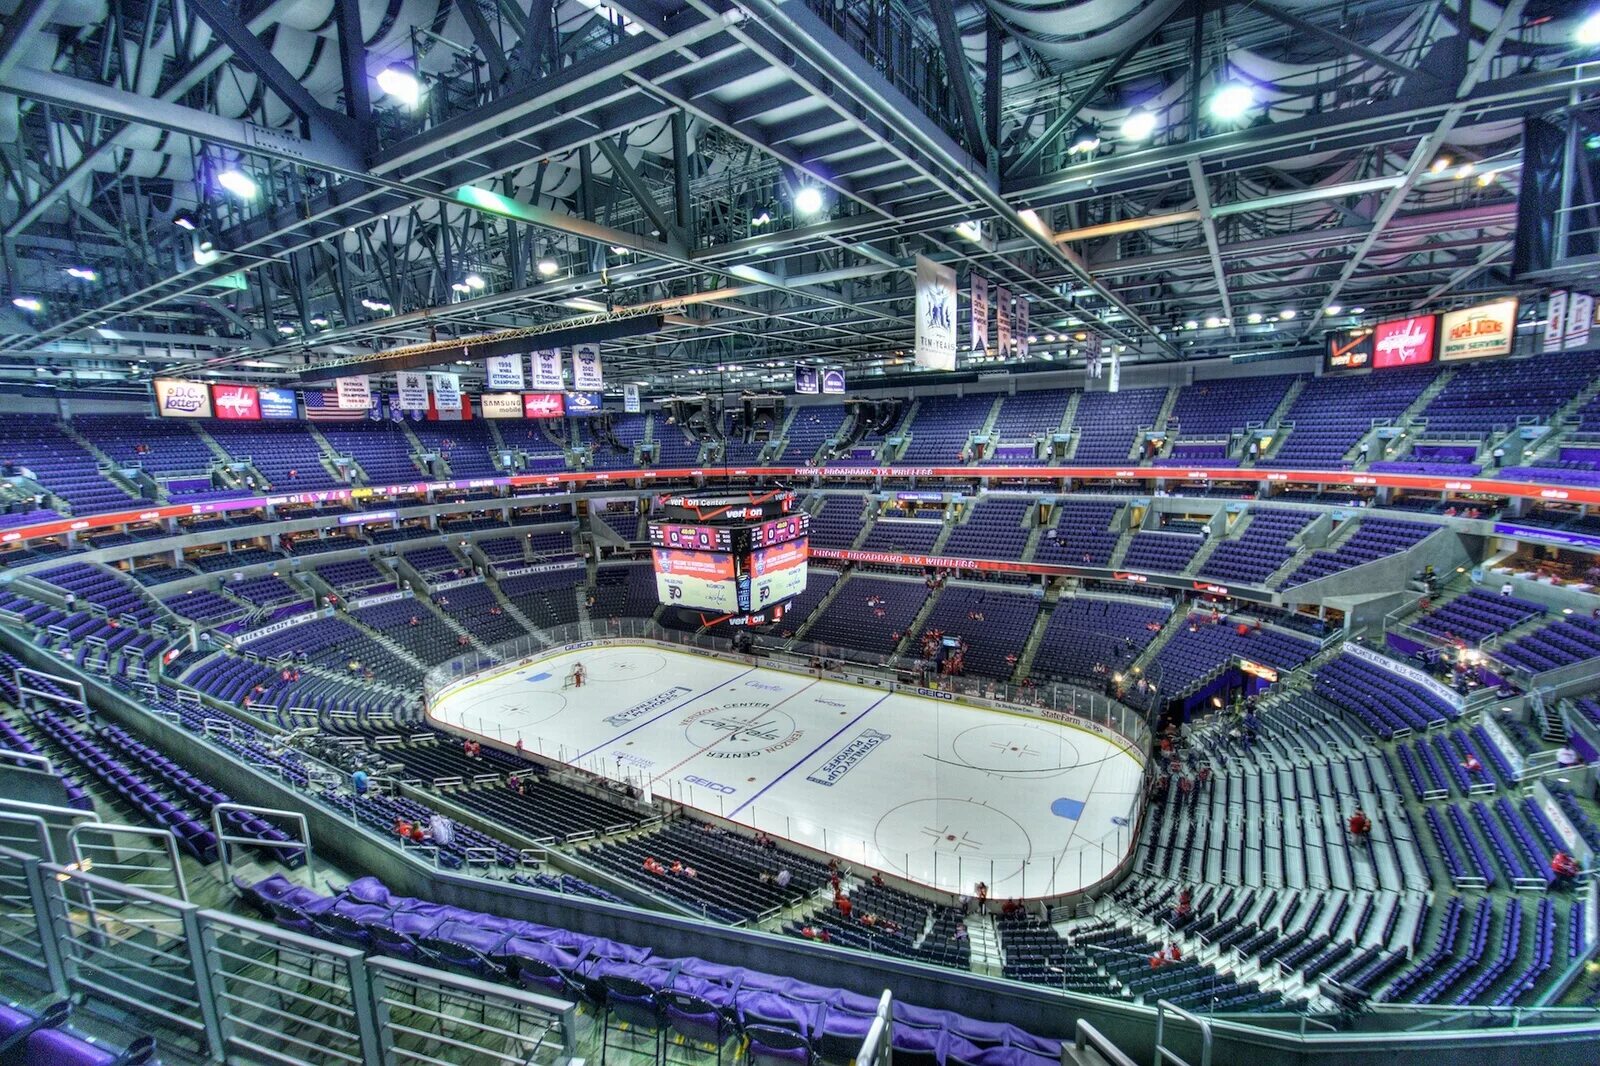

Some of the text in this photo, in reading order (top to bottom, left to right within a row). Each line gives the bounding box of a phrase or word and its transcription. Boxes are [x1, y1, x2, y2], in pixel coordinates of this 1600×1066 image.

[920, 336, 933, 346] TEN
[936, 340, 956, 351] YEARS
[1468, 338, 1508, 350] SERVING
[176, 386, 198, 398] D.C.
[671, 498, 698, 508] verizon
[726, 508, 762, 519] verizon
[671, 532, 678, 542] 0
[700, 534, 708, 544] 0
[729, 614, 765, 626] verizon
[565, 641, 594, 651] GEICO
[917, 688, 952, 700] GEICO
[618, 688, 679, 719] STANLEY CUP
[632, 694, 678, 718] PLAYOFFS
[678, 706, 720, 727] VERIZON
[706, 729, 806, 759] CENTER VERIZON
[822, 740, 864, 774] PLAYOFFS
[828, 738, 879, 782] STANLEY CUP
[684, 774, 736, 794] GEICO
